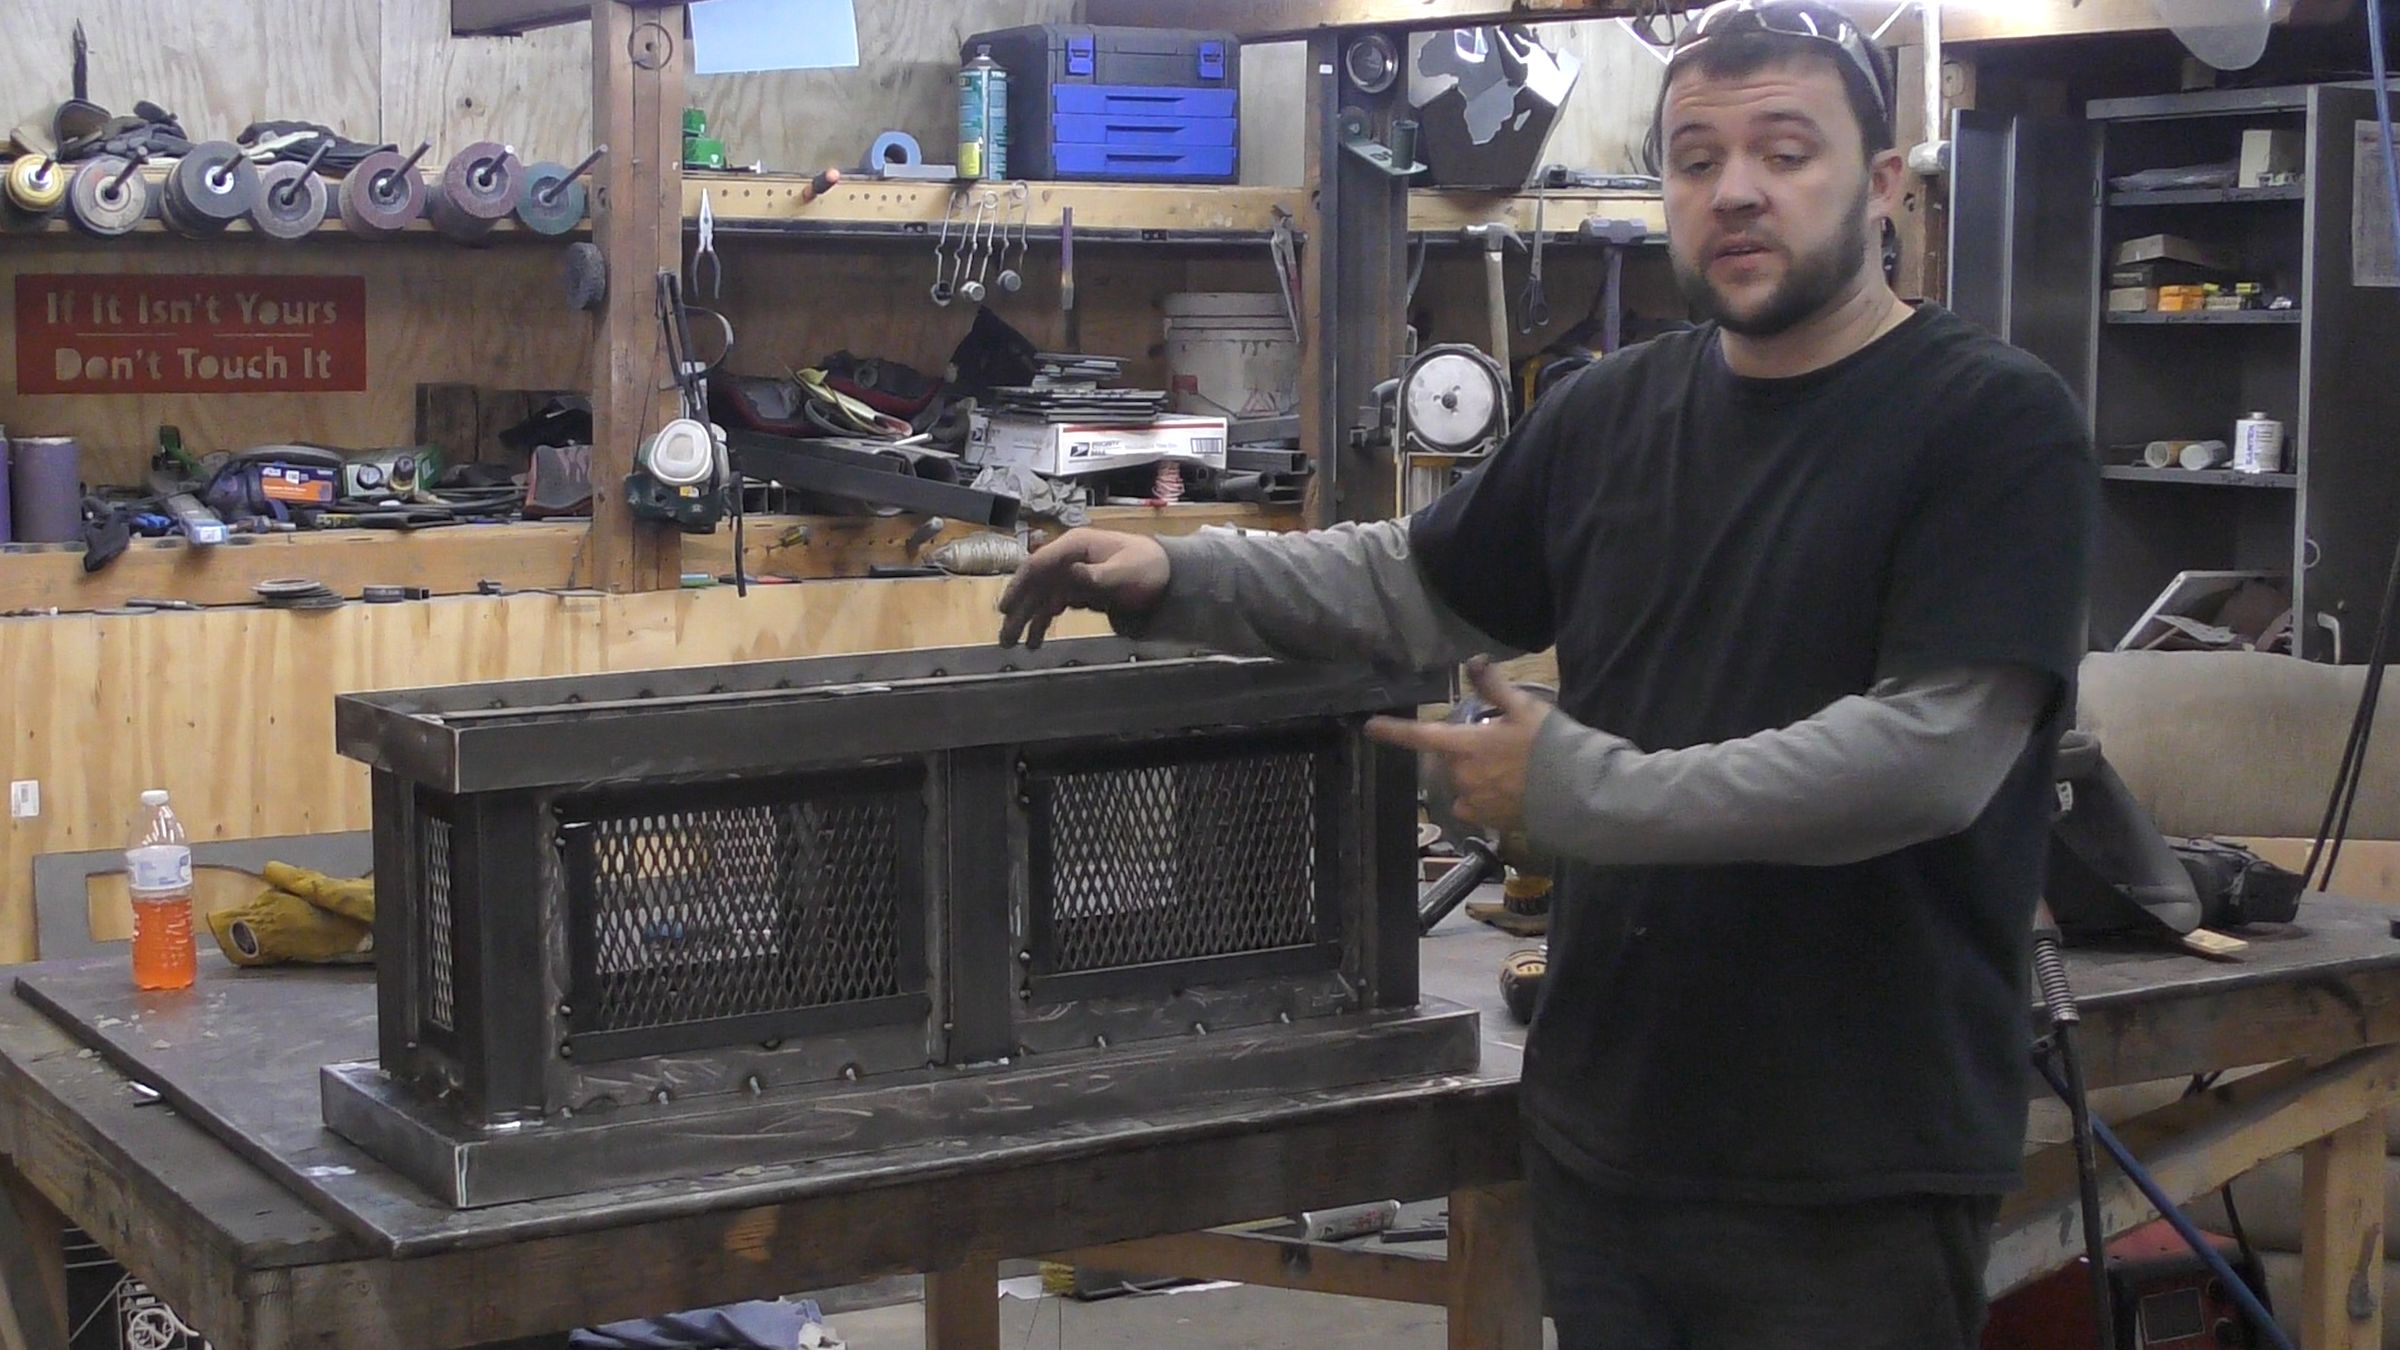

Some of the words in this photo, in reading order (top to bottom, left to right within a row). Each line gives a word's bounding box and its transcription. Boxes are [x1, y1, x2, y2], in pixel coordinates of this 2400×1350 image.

[47, 291, 74, 324] If
[93, 292, 122, 324] It
[138, 292, 222, 324] Isn't
[235, 291, 338, 325] Yours
[55, 347, 163, 381] Don't
[176, 346, 289, 380] Touch
[303, 347, 331, 379] It
